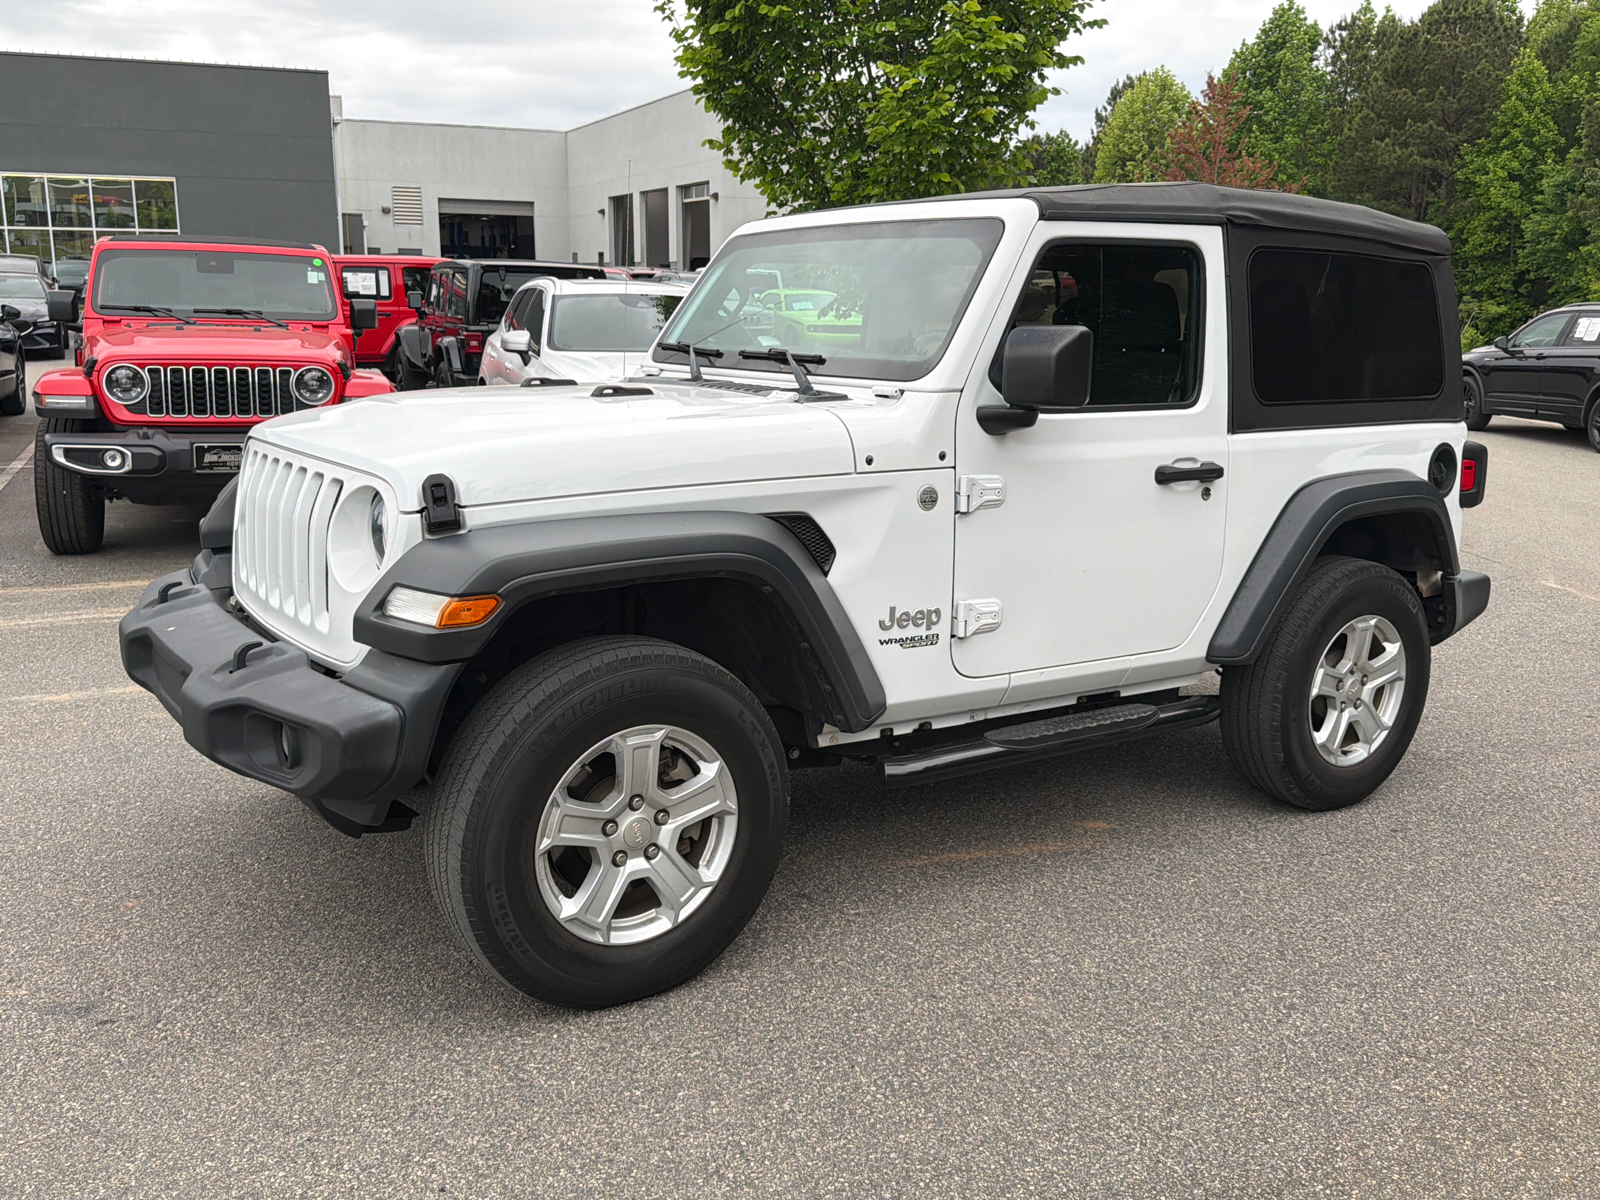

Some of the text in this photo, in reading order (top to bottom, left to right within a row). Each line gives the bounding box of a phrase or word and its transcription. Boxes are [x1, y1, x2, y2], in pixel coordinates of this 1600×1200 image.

[218, 453, 243, 462] JACKSO
[878, 605, 942, 631] Jeep
[878, 633, 940, 646] WRANGLER
[900, 640, 939, 650] SPORT
[553, 674, 664, 735] MICHELIN
[737, 708, 769, 755] LTX
